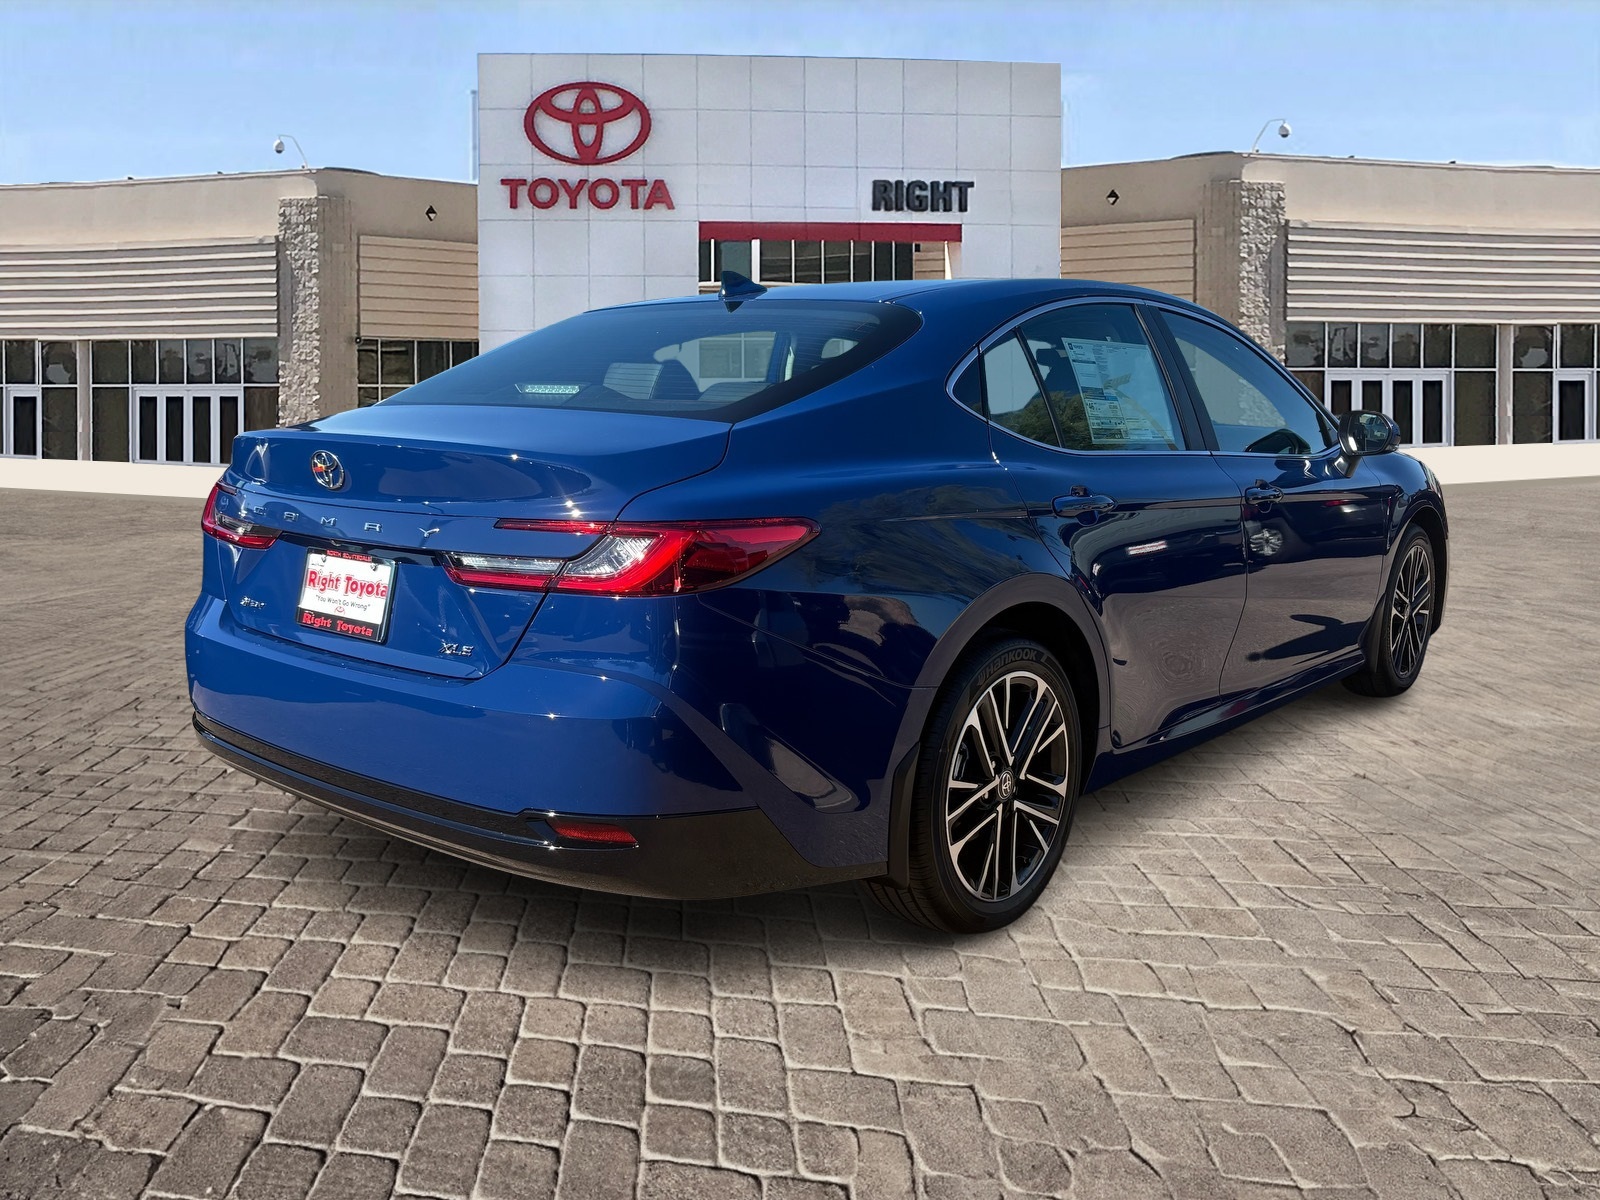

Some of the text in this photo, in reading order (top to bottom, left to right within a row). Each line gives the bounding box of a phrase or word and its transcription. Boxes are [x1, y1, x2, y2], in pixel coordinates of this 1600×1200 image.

[500, 178, 675, 211] TOYOTA
[872, 179, 975, 212] RIGHT
[307, 570, 388, 598] Right Toyota
[302, 612, 373, 636] Right Toyota
[438, 640, 474, 657] XLE
